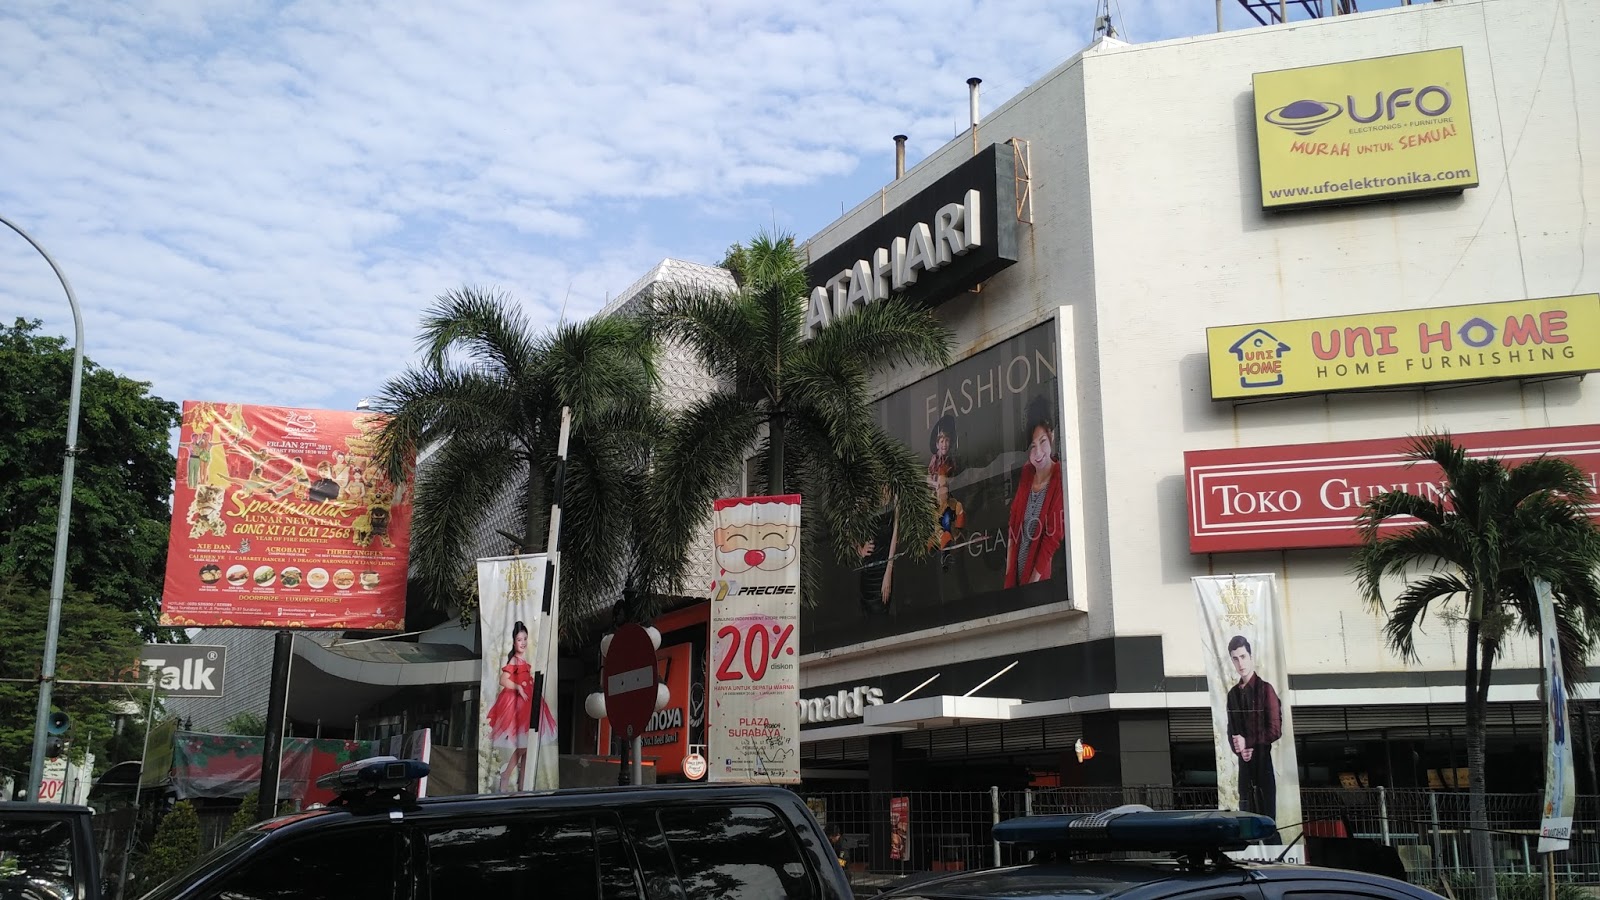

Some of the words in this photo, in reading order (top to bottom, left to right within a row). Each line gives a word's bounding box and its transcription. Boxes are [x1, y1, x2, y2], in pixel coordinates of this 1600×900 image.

[1347, 86, 1452, 123] UFO
[1349, 123, 1402, 134] ELECTRONICS
[1410, 117, 1454, 127] FURNITURE
[1290, 141, 1351, 156] MURAH
[1357, 142, 1394, 155] UNTUK
[1399, 124, 1457, 150] SEMUA!
[1269, 168, 1472, 199] www.ufoelektronika.com
[801, 189, 981, 344] ATAHARI
[1239, 360, 1282, 376] HOME
[1316, 361, 1388, 379] HOME
[1406, 345, 1576, 372] FURNISHING
[925, 342, 1057, 430] FASHION
[1211, 483, 1302, 516] TOKO
[233, 524, 265, 535] GONG
[266, 525, 279, 535] XI
[281, 526, 296, 536] FA
[299, 527, 319, 537] CAI
[321, 527, 351, 539] 2568
[245, 515, 282, 524] LUNAR
[285, 517, 311, 526] NEW
[314, 518, 341, 527] YEAR
[265, 546, 310, 554] ACROBATIC
[738, 586, 796, 596] PRECISE
[716, 624, 794, 681] 20%
[728, 728, 780, 737] SURABAYA
[740, 718, 770, 726] PLAZA
